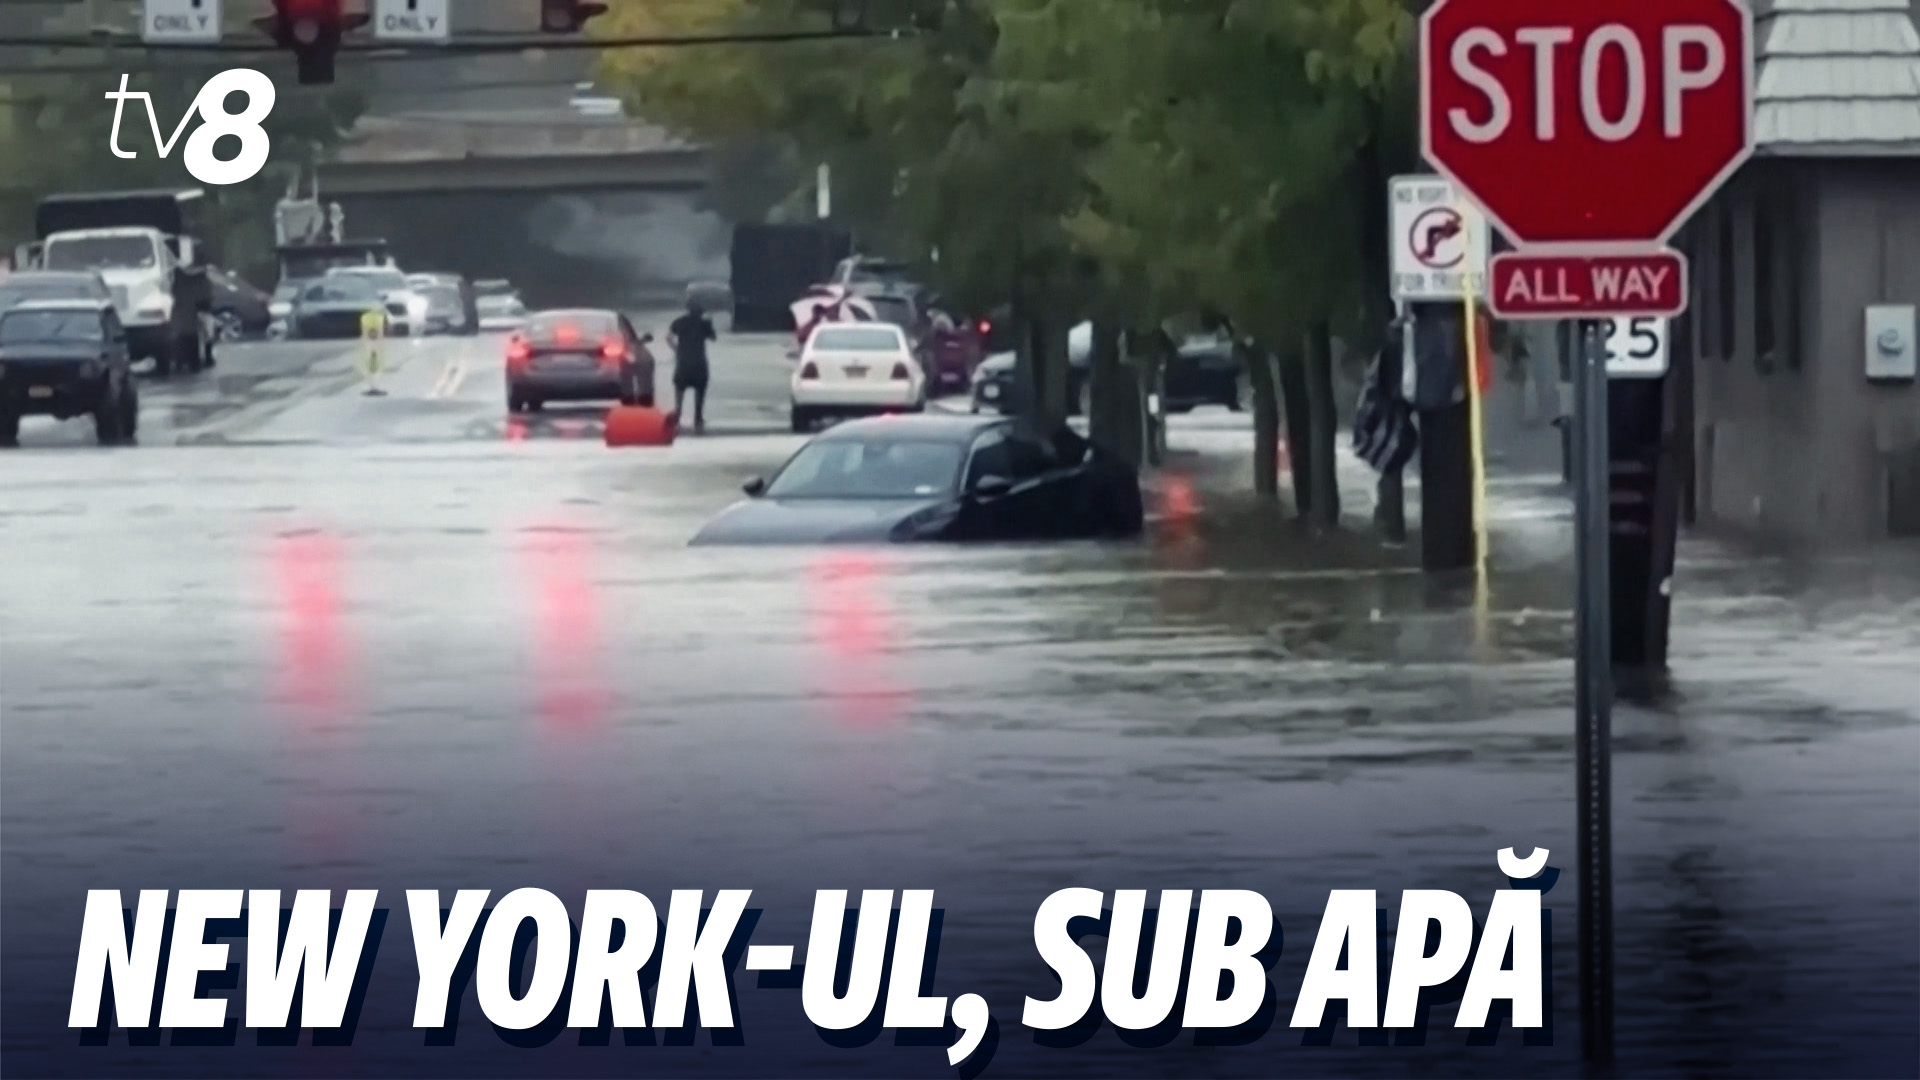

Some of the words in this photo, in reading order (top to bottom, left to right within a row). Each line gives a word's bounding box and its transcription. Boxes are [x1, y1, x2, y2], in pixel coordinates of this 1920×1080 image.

[153, 14, 209, 32] ONLY
[384, 14, 438, 32] ONLY
[1447, 23, 1727, 144] STOP
[1503, 266, 1581, 303] ALL
[1590, 265, 1670, 302] WAY
